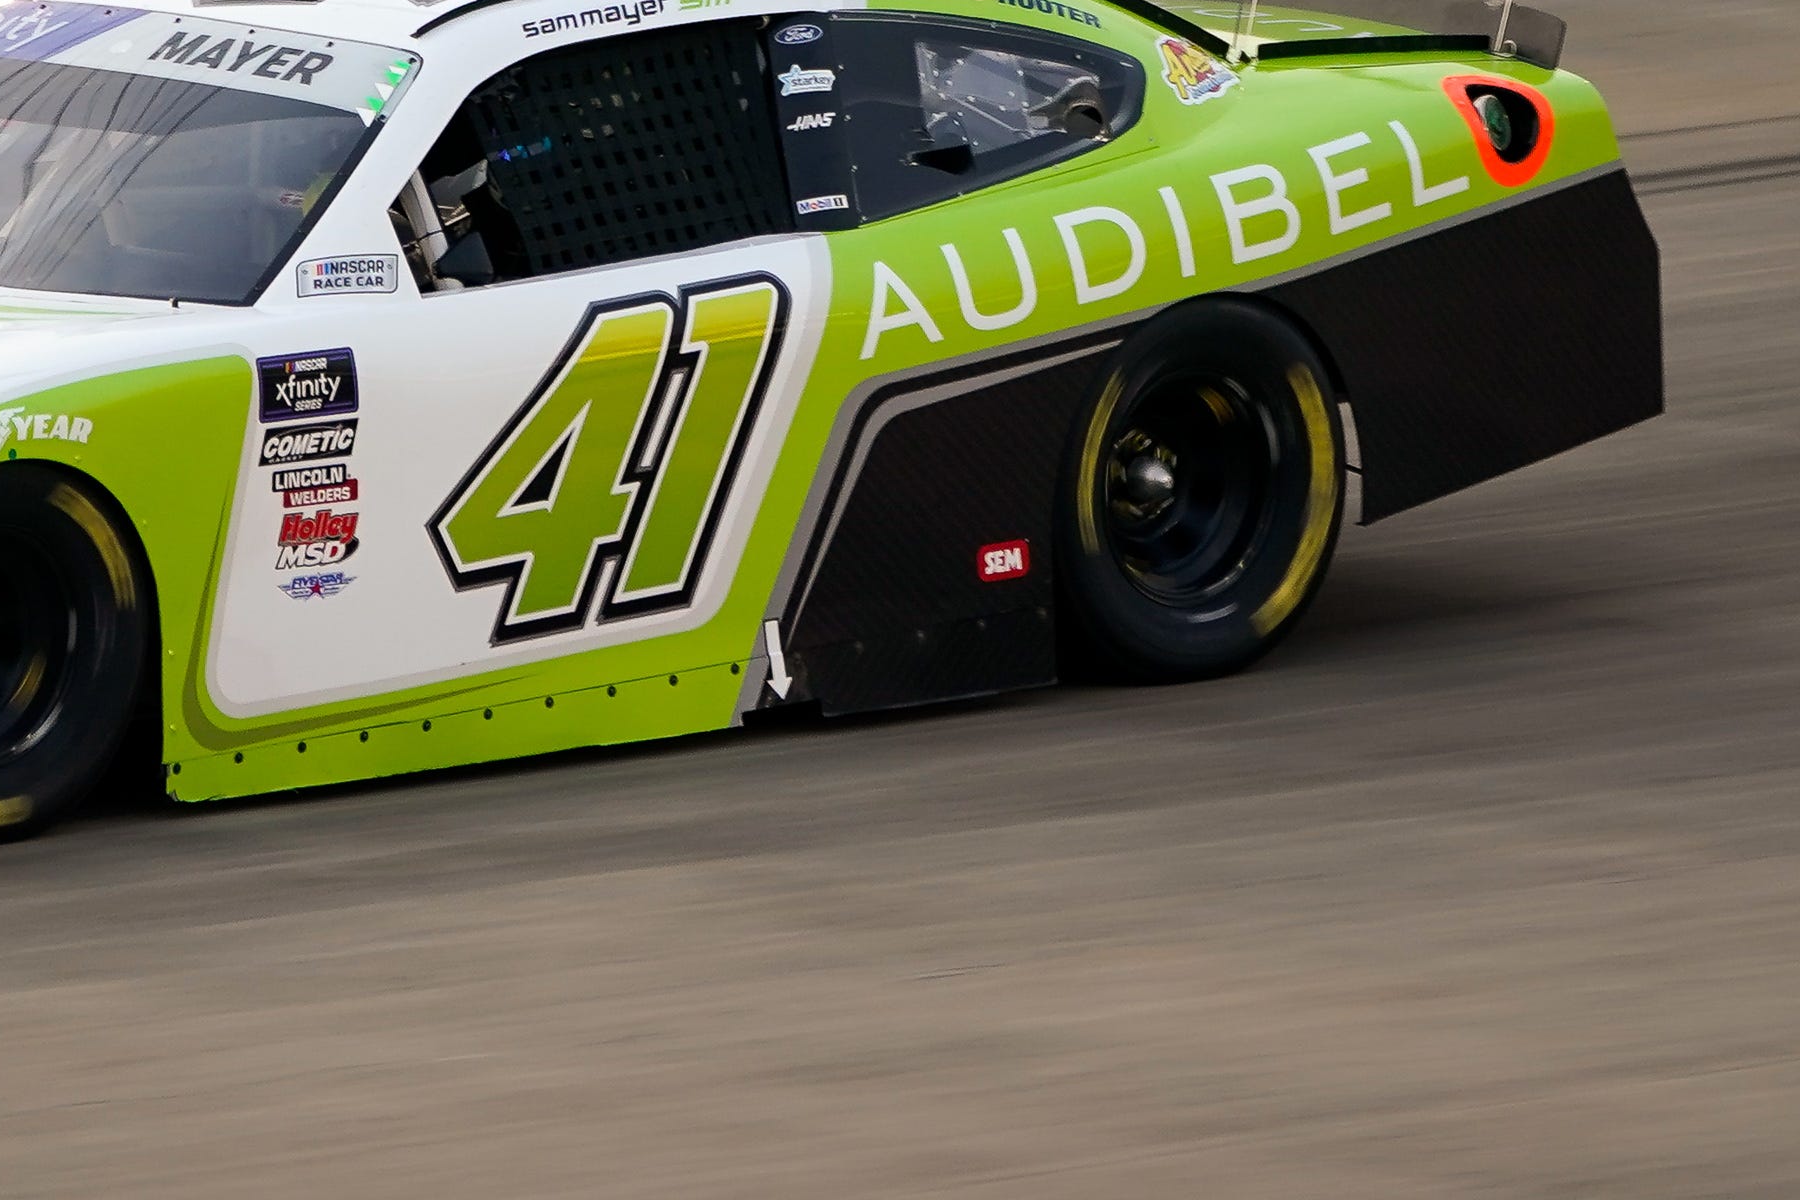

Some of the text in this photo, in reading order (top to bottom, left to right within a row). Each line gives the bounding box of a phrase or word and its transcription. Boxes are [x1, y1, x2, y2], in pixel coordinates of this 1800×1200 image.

[784, 27, 816, 42] Ford
[148, 31, 334, 86] MAYER
[786, 112, 837, 132] HAAS
[861, 119, 1470, 360] AUDIBEL
[329, 259, 385, 275] NASCAR
[313, 275, 385, 289] RACE CAR
[293, 357, 328, 372] NASCAR
[275, 373, 341, 407] xfinity
[293, 398, 323, 412] SERIES
[263, 427, 355, 459] COMETIC
[424, 271, 792, 649] 41
[274, 466, 344, 490] LINCOLN
[289, 486, 351, 506] WELDERS
[278, 509, 359, 545] Holley
[275, 541, 346, 570] MSD
[983, 547, 1023, 575] SEM
